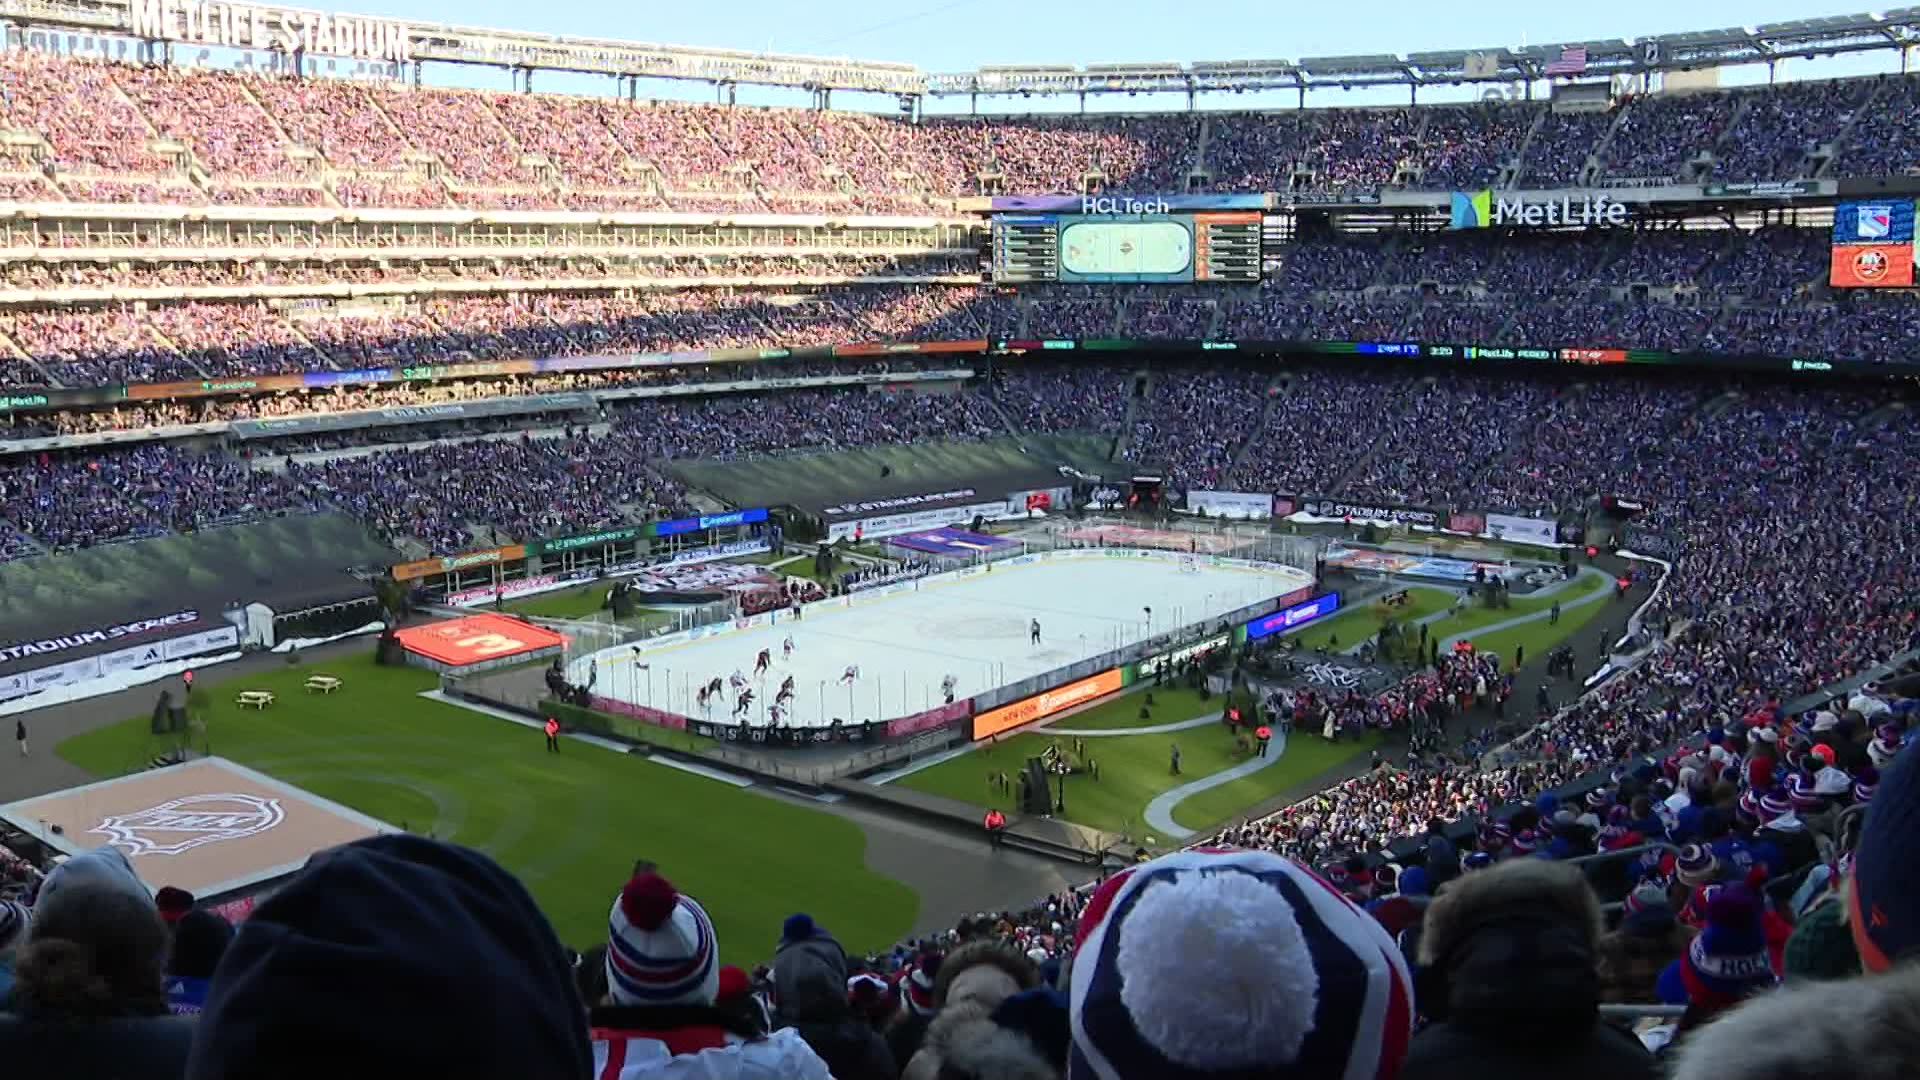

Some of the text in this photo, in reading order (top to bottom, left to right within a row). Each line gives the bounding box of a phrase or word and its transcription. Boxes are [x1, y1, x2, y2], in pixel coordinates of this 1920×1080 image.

[131, 0, 410, 61] METLIFE STADIUM
[1082, 197, 1169, 214] HCLTech
[1496, 193, 1628, 225] MetLife
[1333, 504, 1388, 520] STADIUM
